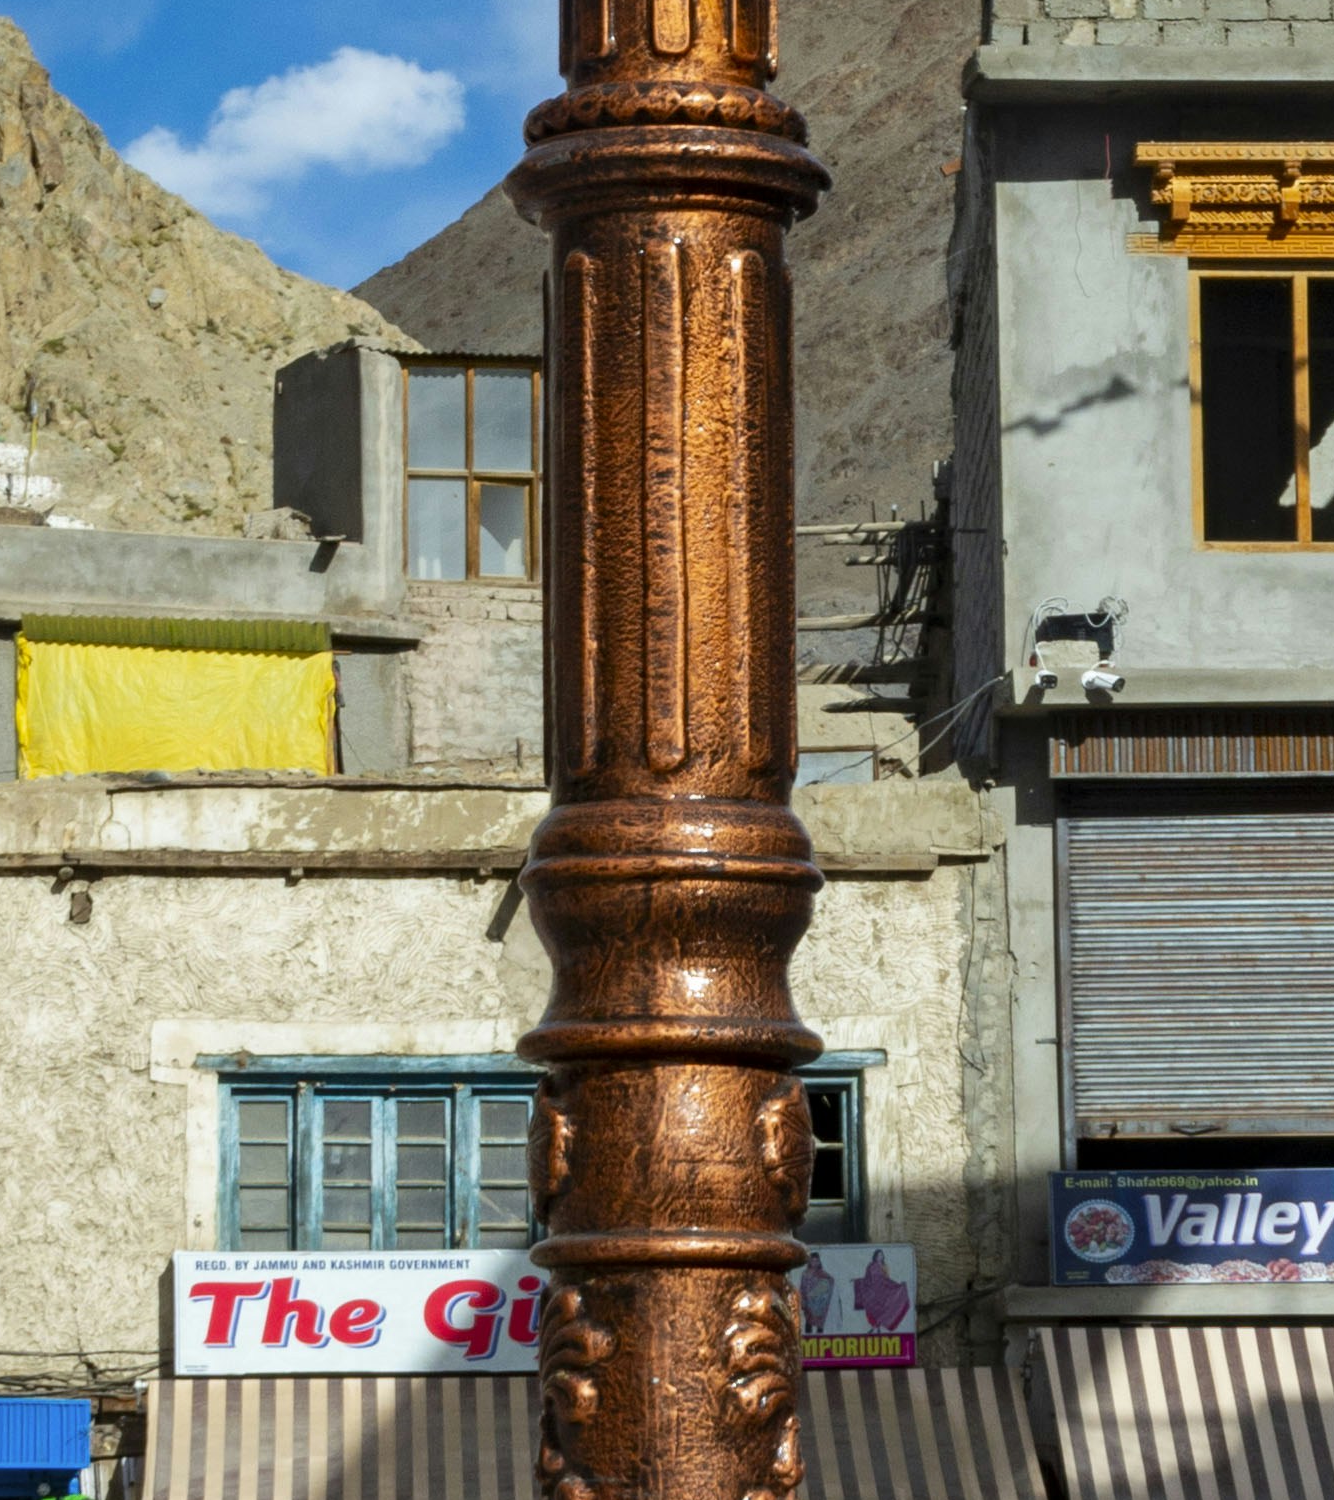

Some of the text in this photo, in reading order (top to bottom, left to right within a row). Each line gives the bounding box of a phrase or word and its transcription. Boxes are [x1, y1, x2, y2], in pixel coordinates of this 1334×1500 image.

[1065, 1175, 1259, 1190] E-mail: Shafat969@yahoo.in
[195, 1259, 471, 1271] REGD. BY JAMMU AND KASHMIR GOVERNMENT
[188, 1274, 542, 1362] The Gi
[801, 1335, 902, 1359] MPORIUM
